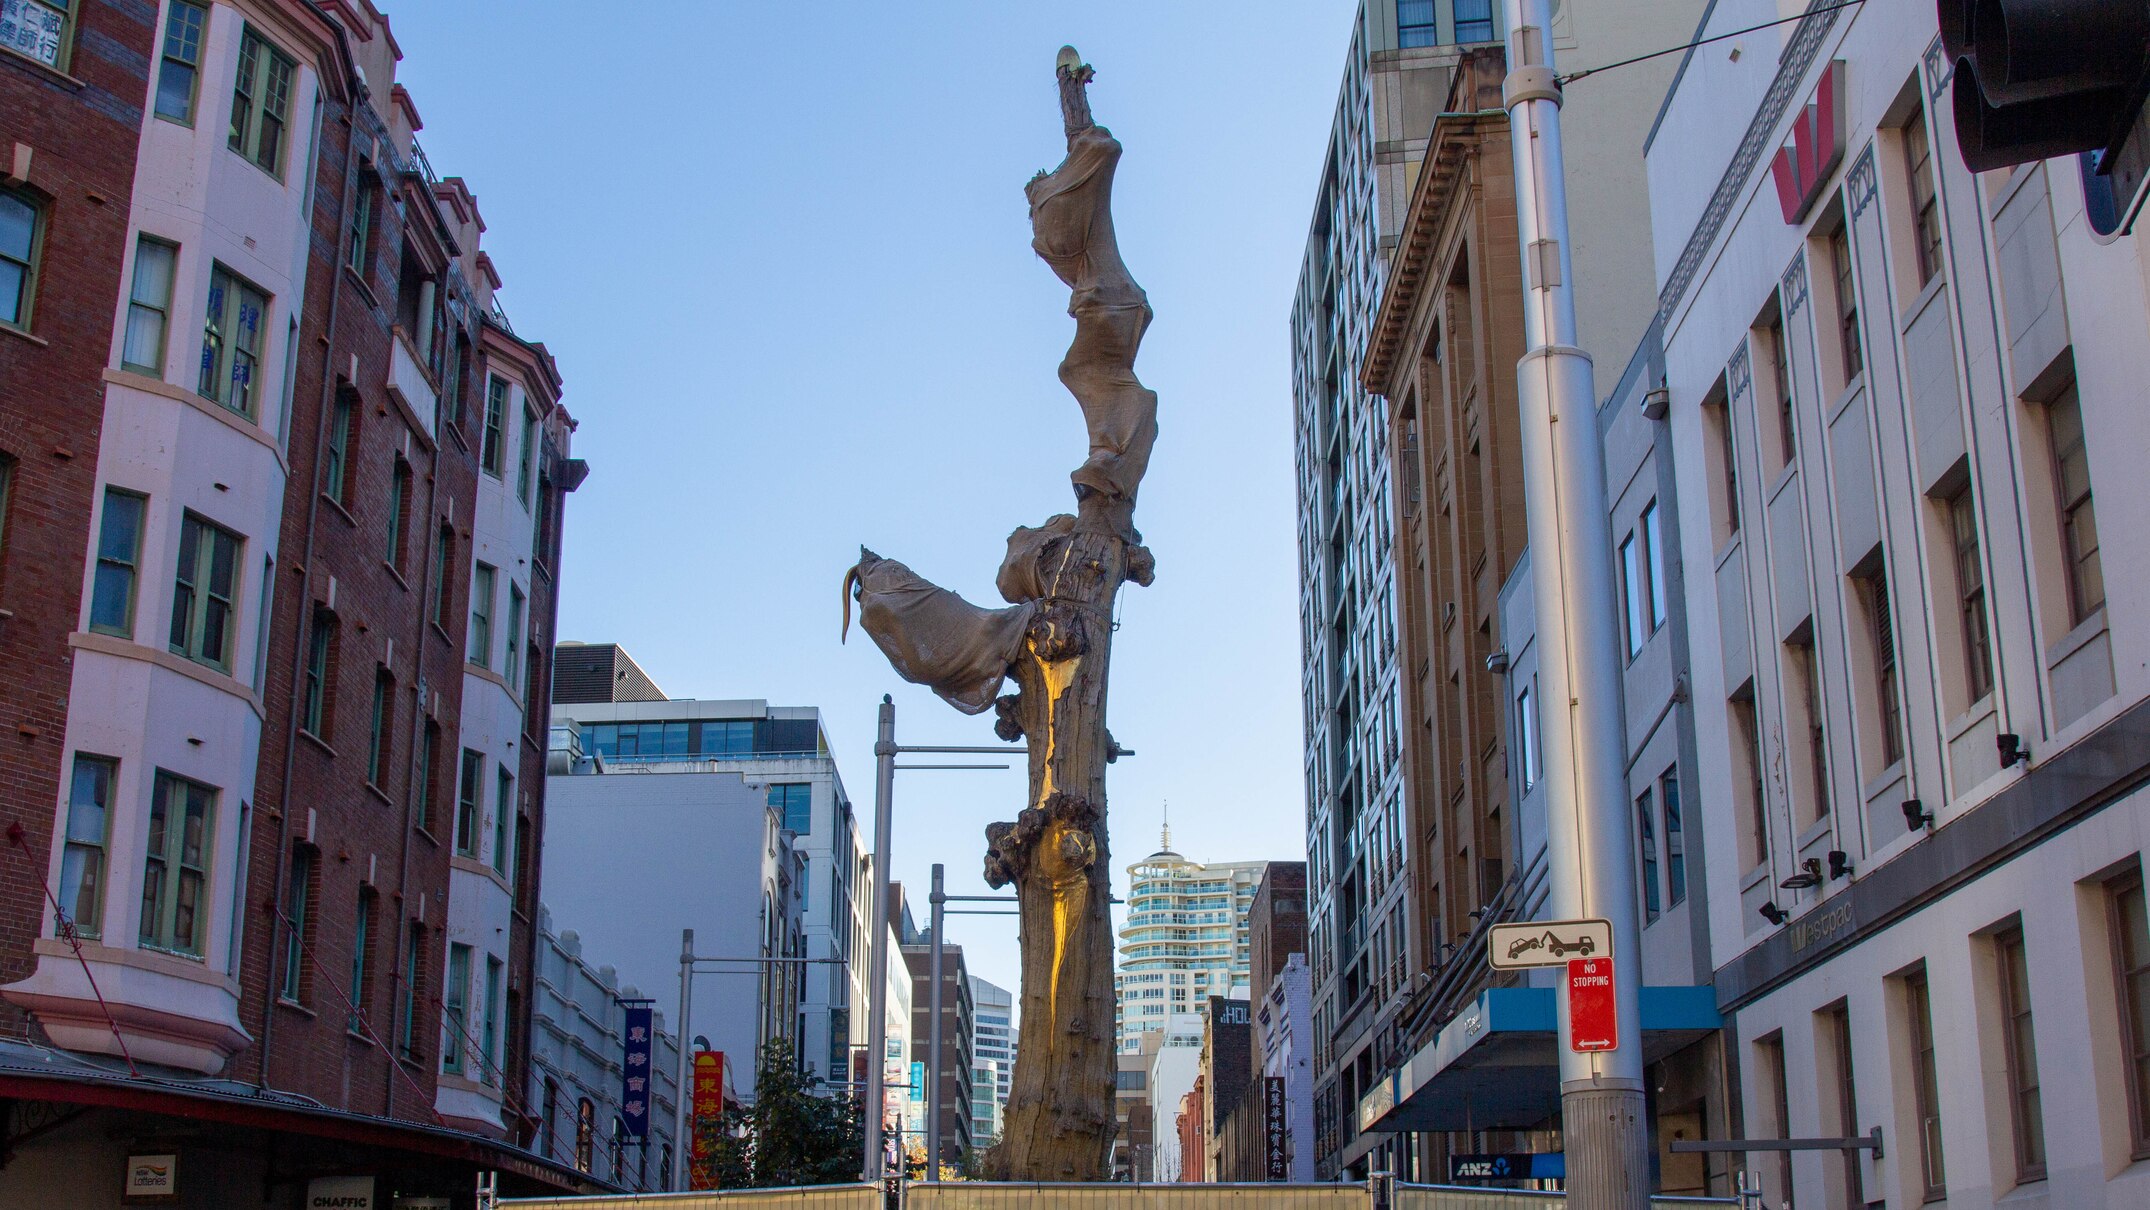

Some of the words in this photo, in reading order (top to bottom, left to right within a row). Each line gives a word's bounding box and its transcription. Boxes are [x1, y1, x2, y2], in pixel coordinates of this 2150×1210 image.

[1790, 902, 1853, 954] Westpac
[1584, 963, 1597, 974] NO
[1573, 976, 1609, 987] STOPPING
[1456, 1162, 1492, 1176] ANZ
[134, 1175, 167, 1186] Lotteries
[313, 1197, 367, 1208] CHAFFIC
